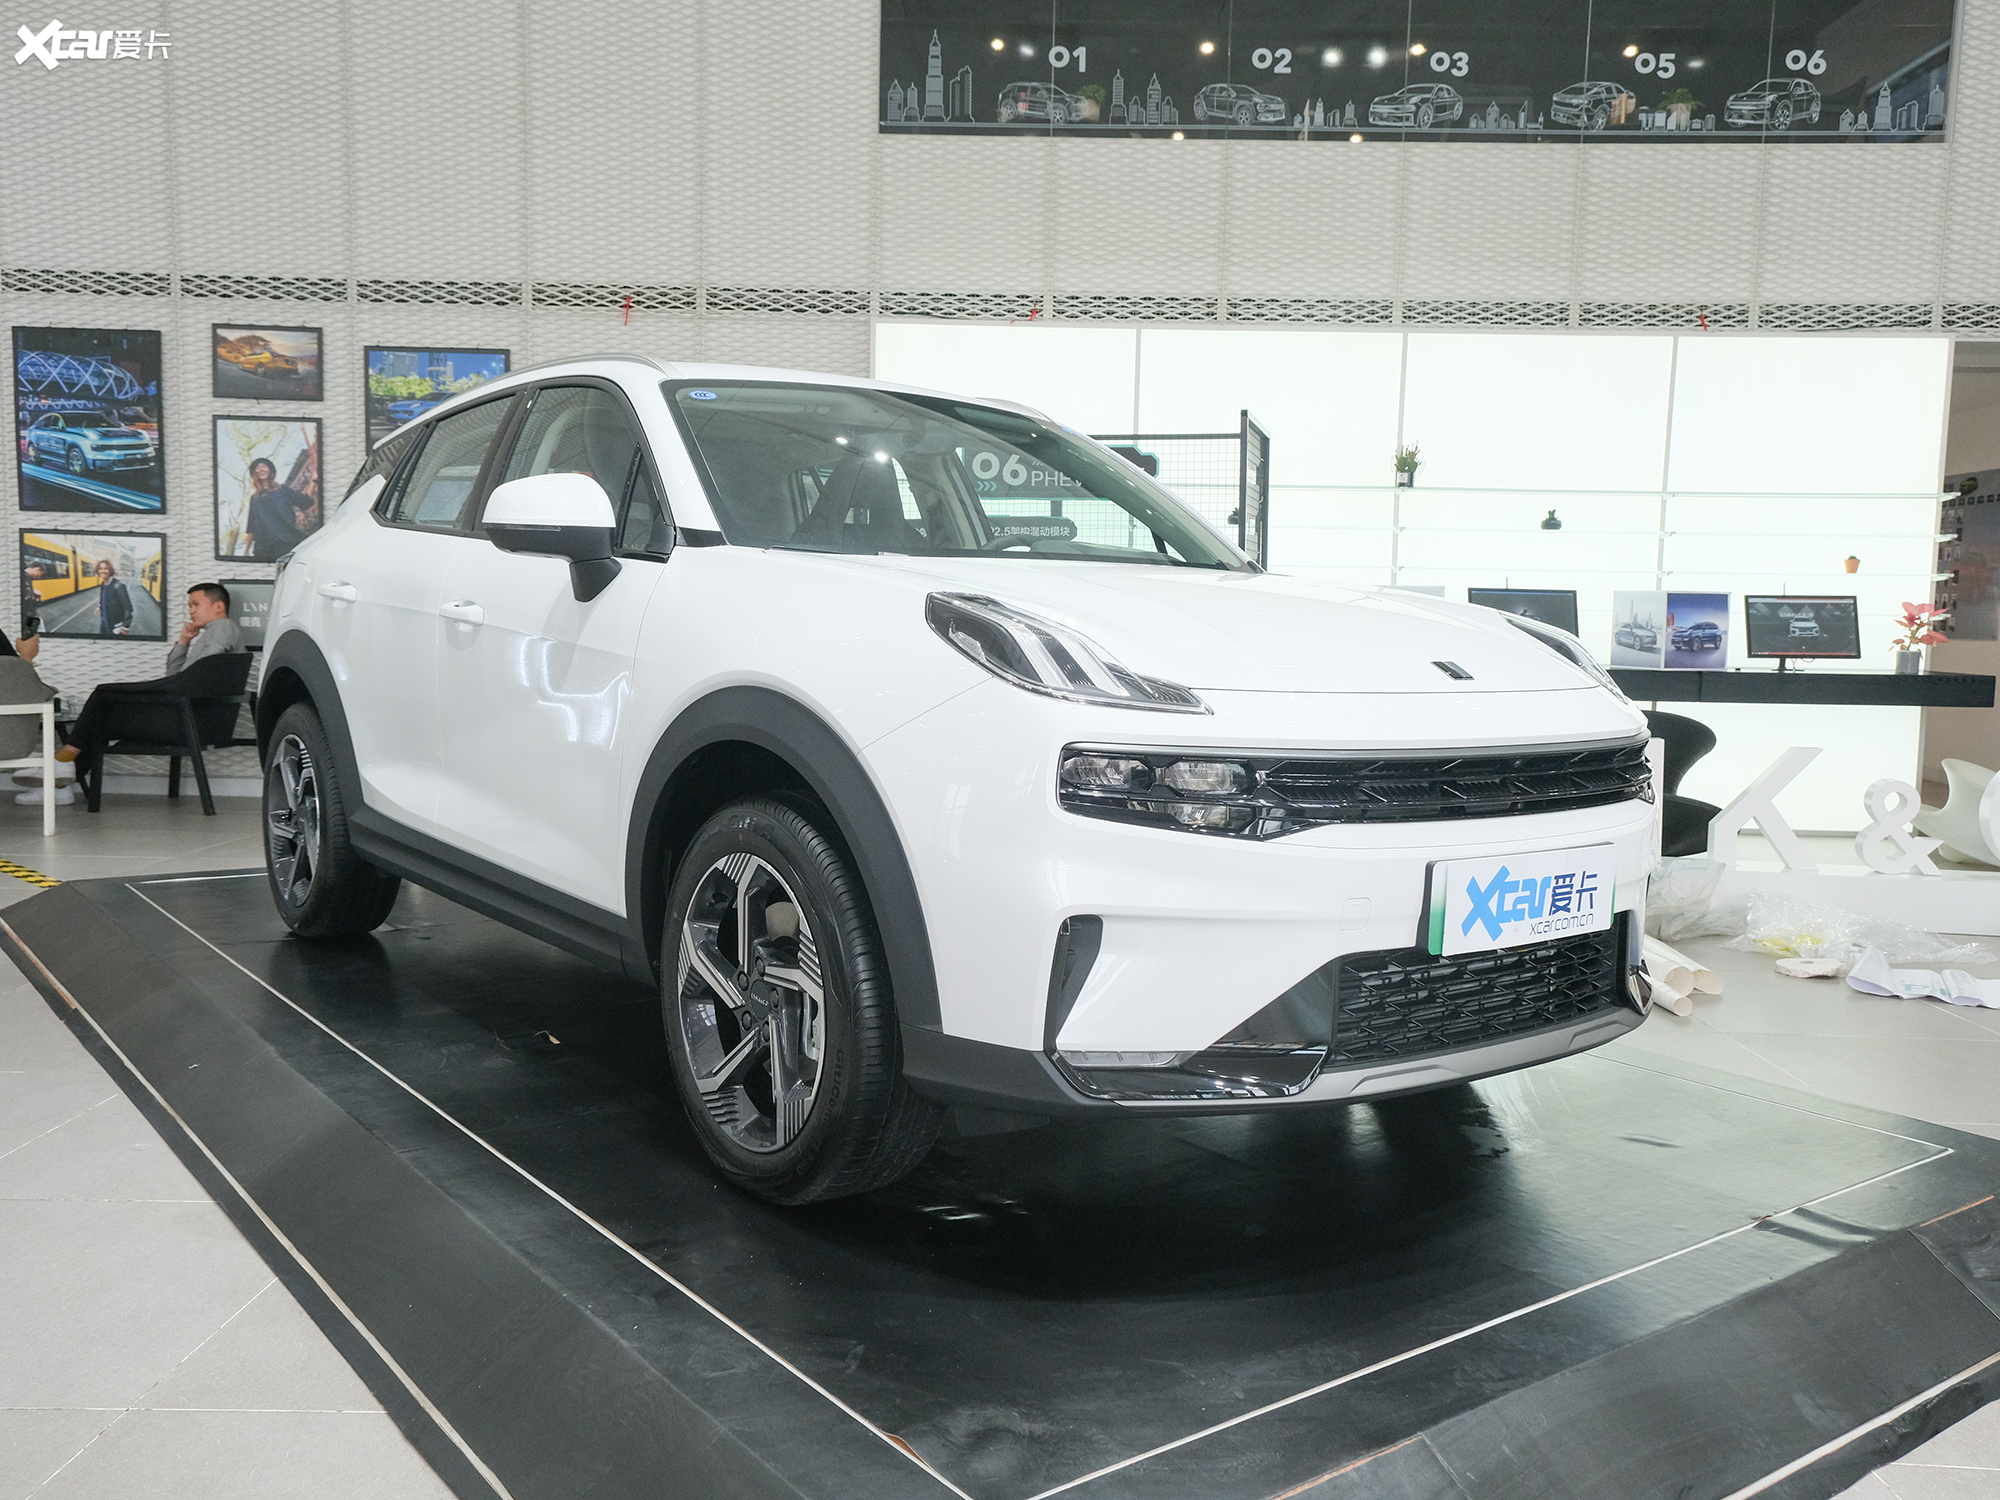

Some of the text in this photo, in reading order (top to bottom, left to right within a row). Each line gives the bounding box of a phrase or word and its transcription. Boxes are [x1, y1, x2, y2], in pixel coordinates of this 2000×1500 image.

[1048, 45, 1087, 73] 01
[1251, 46, 1293, 74] 02
[1429, 51, 1470, 78] 03
[1633, 51, 1676, 79] 05
[1784, 49, 1827, 76] 06
[972, 451, 1028, 486] 06
